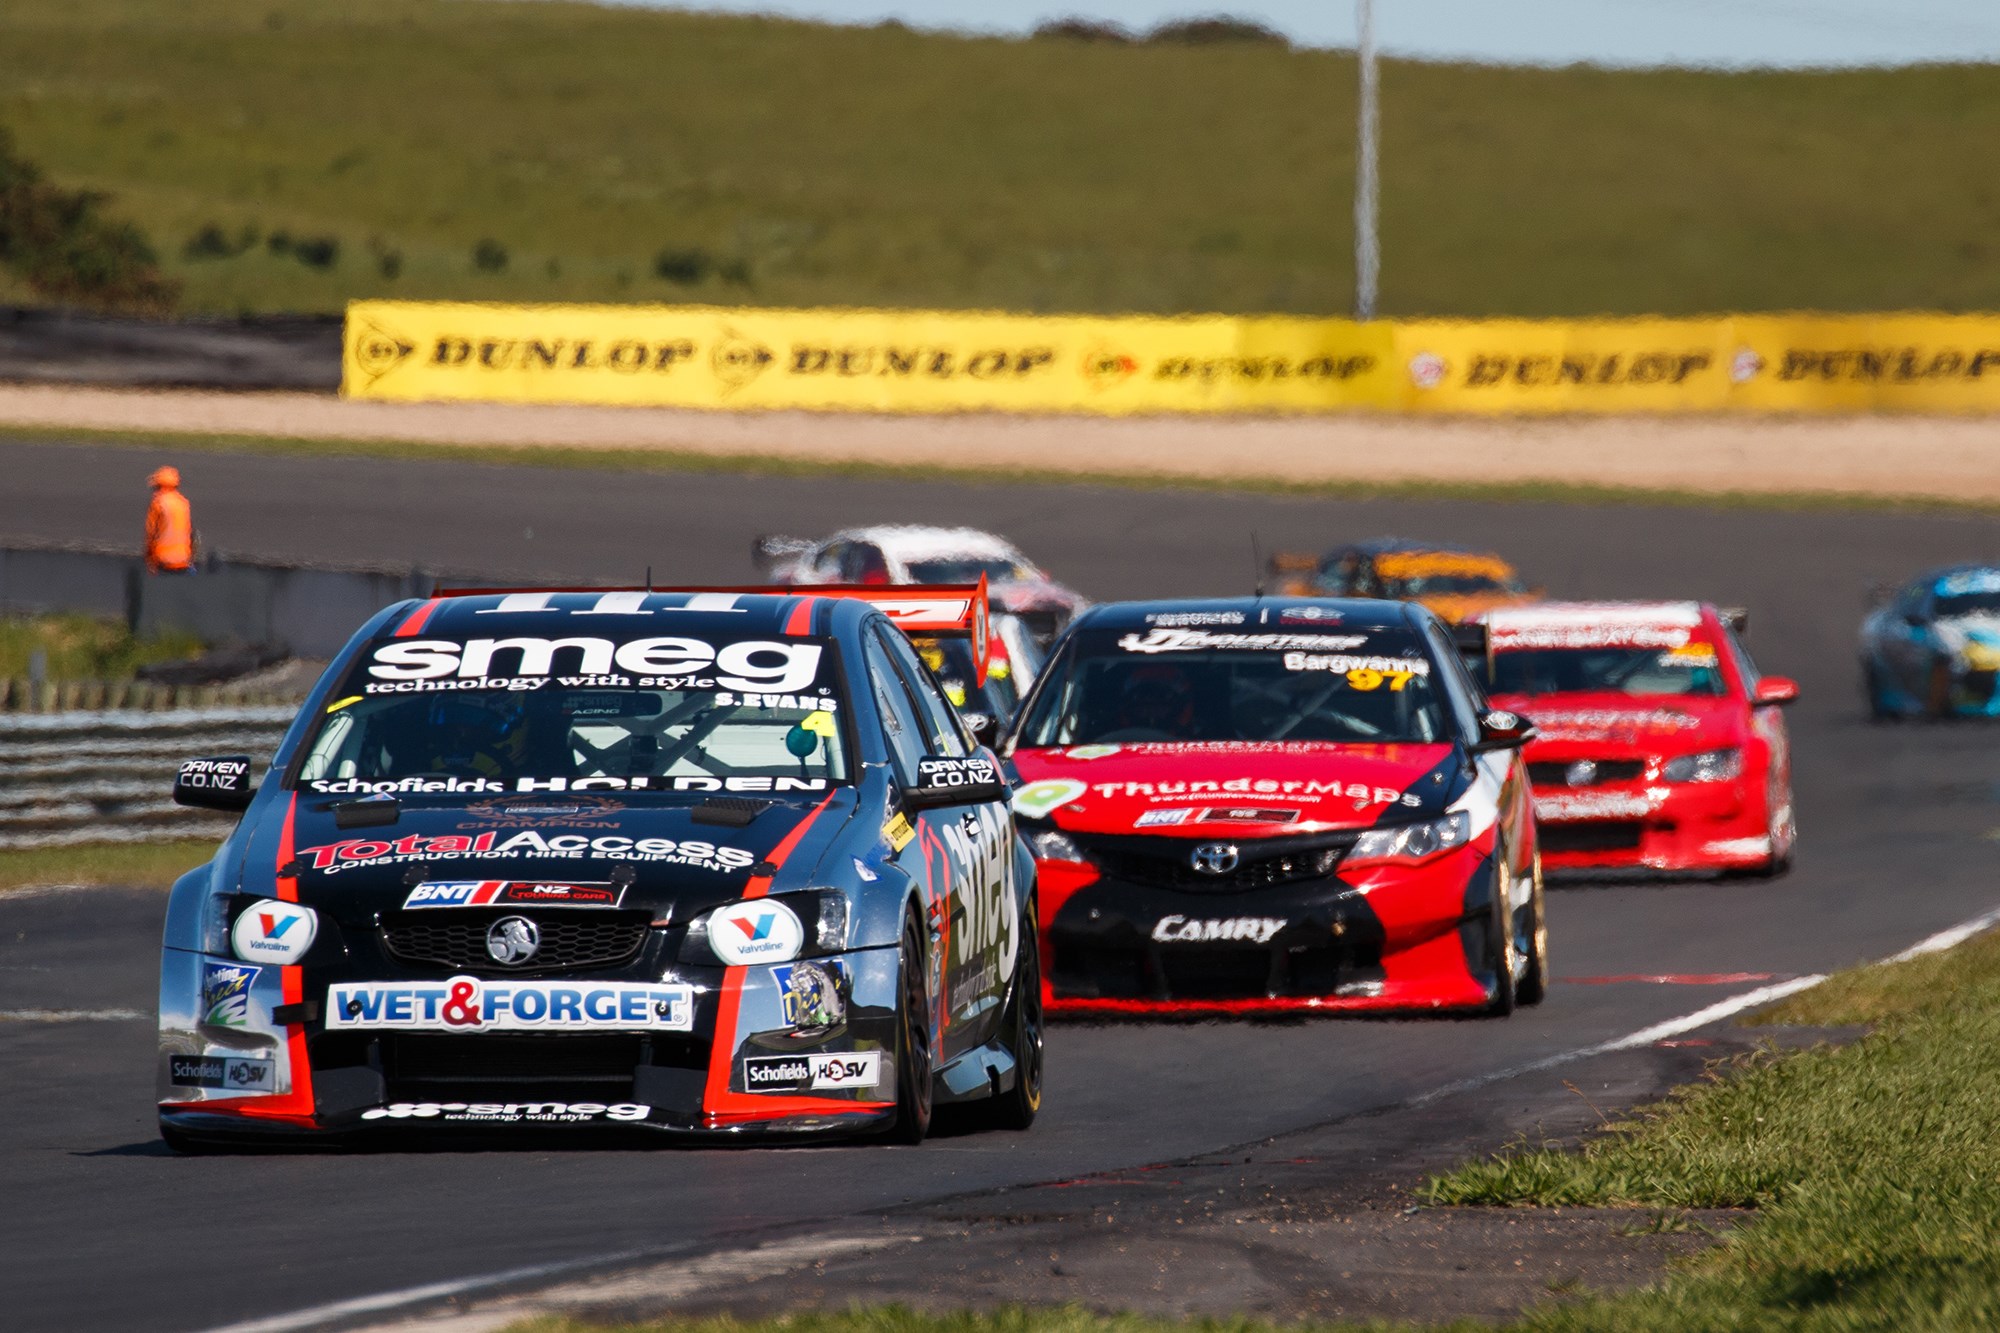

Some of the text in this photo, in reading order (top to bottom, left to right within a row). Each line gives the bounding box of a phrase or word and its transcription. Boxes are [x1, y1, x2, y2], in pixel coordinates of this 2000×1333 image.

[427, 335, 697, 374] DUNLOP
[788, 344, 1055, 379] DUNLOP
[1467, 351, 1710, 387] DUNLOP
[368, 636, 823, 694] smeg
[365, 674, 716, 694] technology with style
[1346, 669, 1415, 691] 97
[715, 692, 837, 711] S.EVANS
[179, 761, 247, 775] DRIVEN
[920, 759, 994, 773] DRIVEN
[311, 778, 504, 792] Schofields
[928, 770, 995, 788] .CO.NZ
[1093, 778, 1422, 807] ThunderMaps
[456, 821, 621, 830] CHAMPION
[297, 831, 754, 868] Total Access
[324, 850, 737, 874] CONSTRUCTION HIRE EQUIPMENT
[411, 885, 474, 900] BNT
[533, 884, 571, 893] NZ
[1151, 916, 1289, 943] CAMRY
[250, 940, 290, 951] Valvoline
[737, 942, 784, 954] Valvoline
[174, 1062, 223, 1078] Schofields
[750, 1062, 808, 1081] Schofields
[445, 1112, 593, 1121] technology with style
[466, 1103, 651, 1121] smeg
